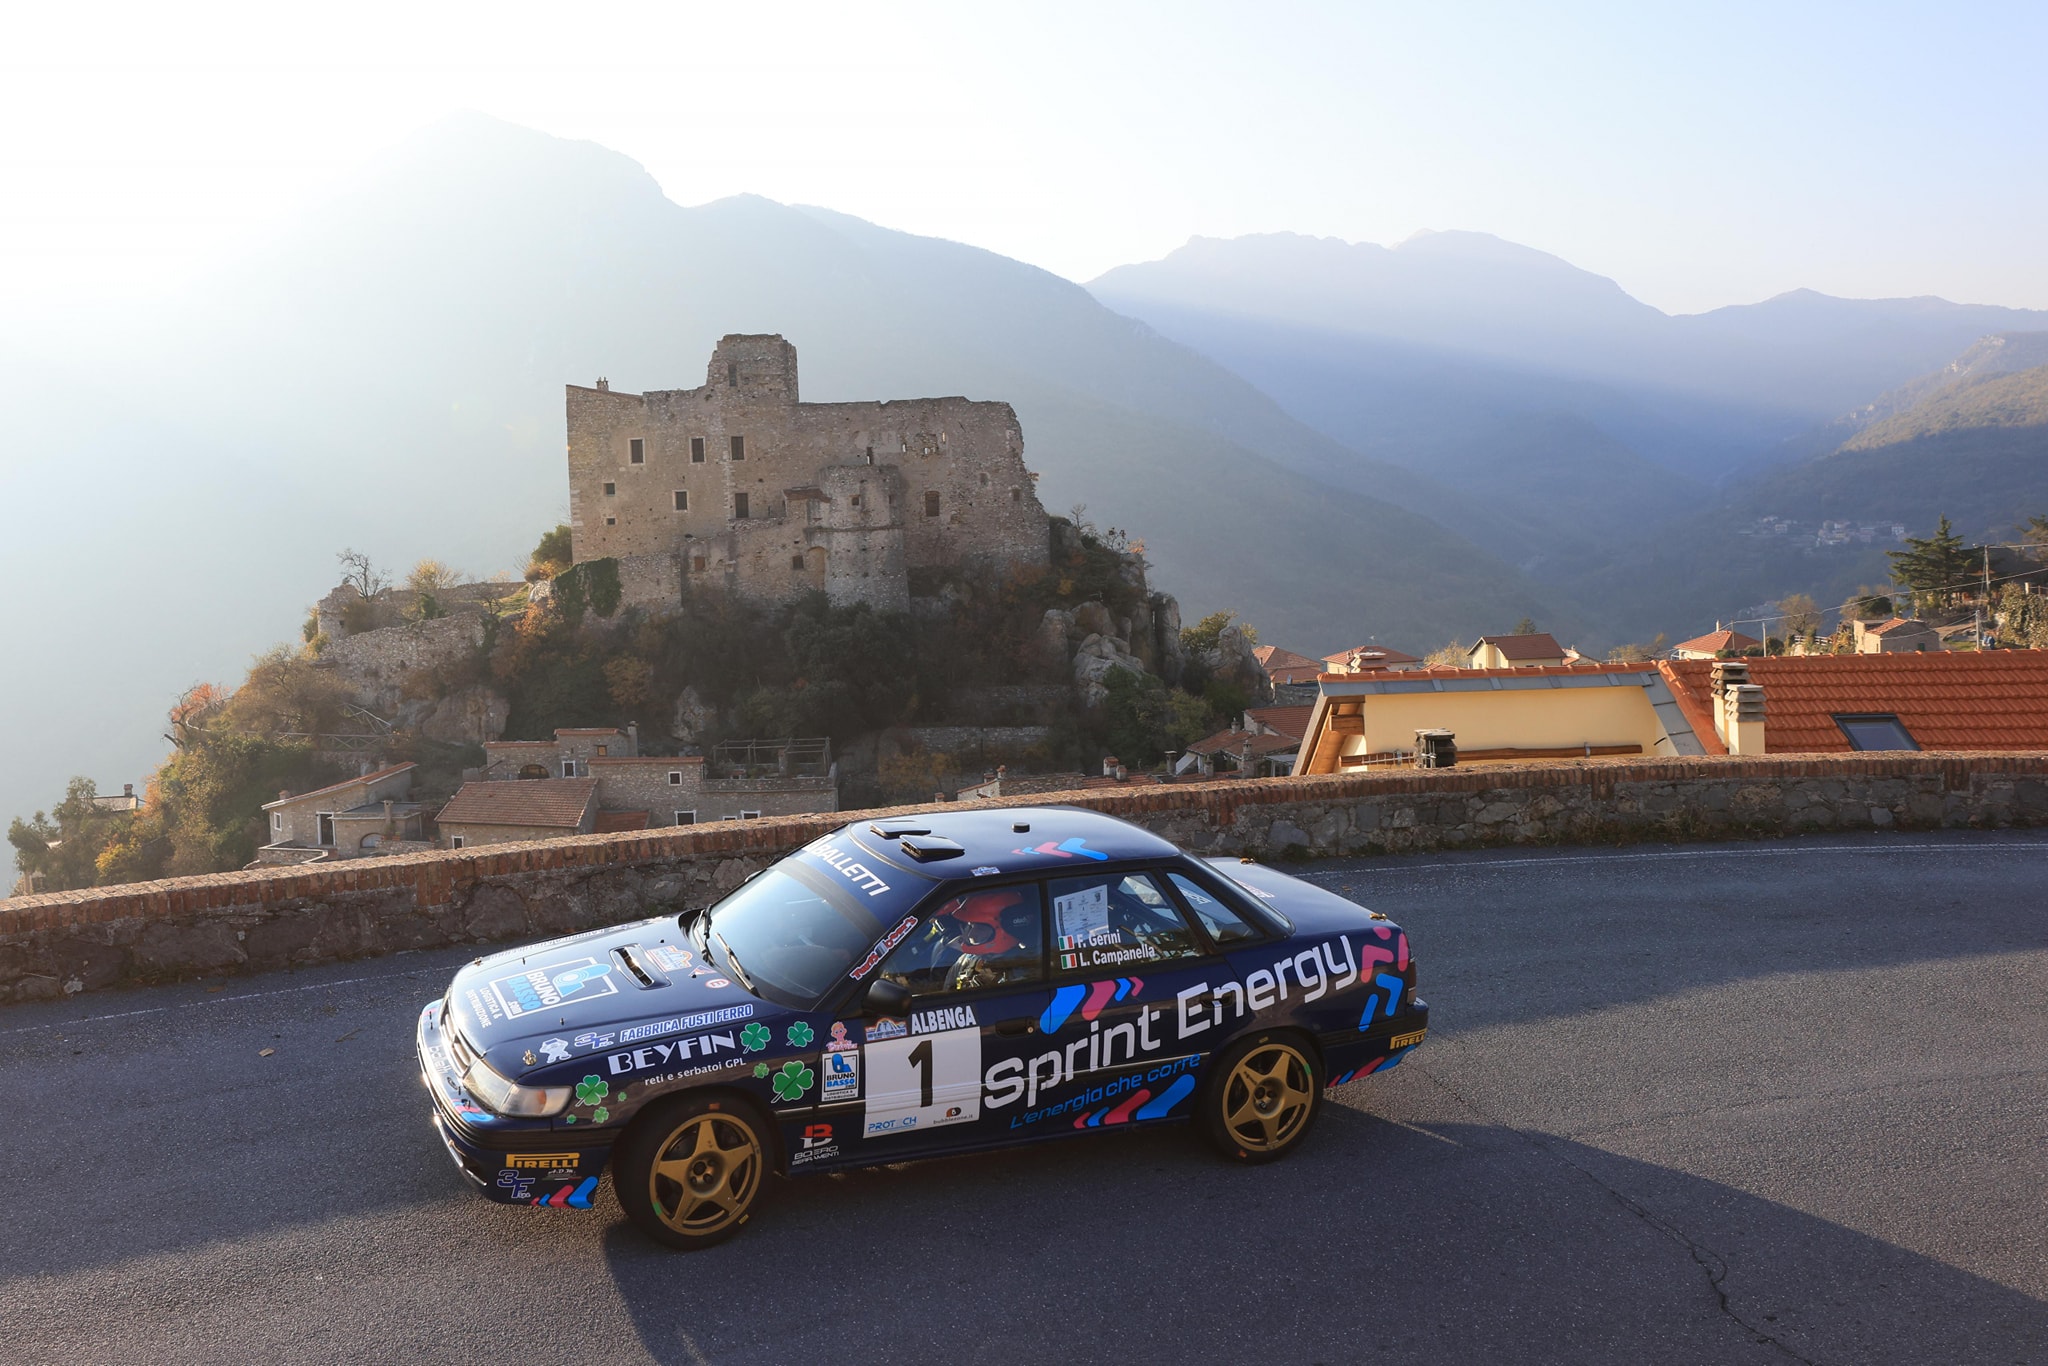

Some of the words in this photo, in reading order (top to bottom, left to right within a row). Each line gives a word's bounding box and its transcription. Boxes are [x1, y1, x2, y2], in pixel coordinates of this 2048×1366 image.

[1077, 935, 1086, 948] F.
[1089, 929, 1121, 947] Gerini
[1080, 954, 1090, 967] L.
[1093, 945, 1155, 966] Campanella
[507, 976, 542, 1011] BASSO
[526, 971, 561, 1005] BRUNO
[620, 1017, 680, 1043] FABBRICA
[681, 1009, 715, 1030] FUSTI
[715, 1003, 754, 1023] FERRO
[911, 1005, 977, 1035] ALBENGA
[984, 1005, 1161, 1109] Sprint
[1176, 934, 1358, 1041] Energy
[607, 1030, 736, 1076] BEYFIN
[644, 1076, 664, 1087] reti
[668, 1073, 674, 1081] e
[677, 1061, 723, 1080] serbatoi
[725, 1056, 747, 1070] GPL
[826, 1071, 856, 1081] BRUNO
[826, 1078, 855, 1088] BASSO
[908, 1039, 933, 1108] 1
[1010, 1086, 1103, 1129] L'energia
[1105, 1072, 1143, 1098] che
[1147, 1053, 1201, 1082] corre
[867, 1115, 917, 1132] PROTCH
[505, 1152, 580, 1168] PIRELLI
